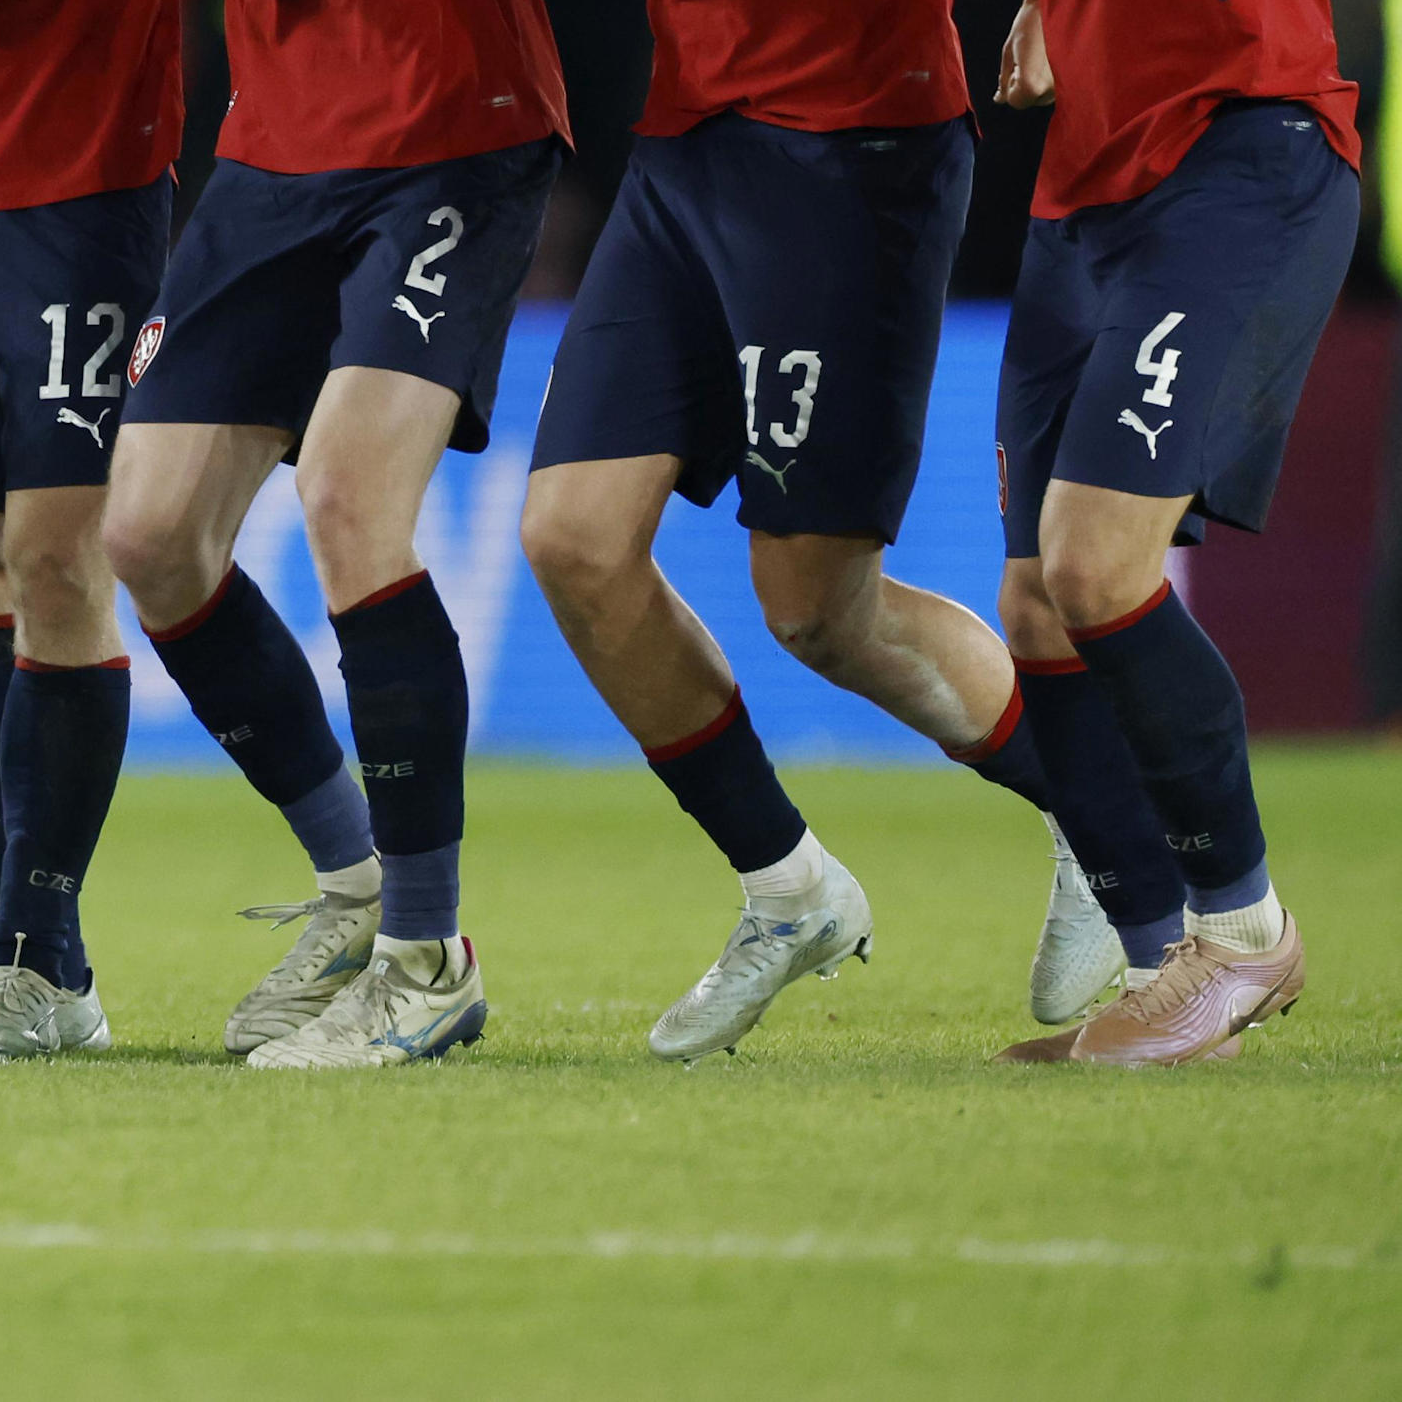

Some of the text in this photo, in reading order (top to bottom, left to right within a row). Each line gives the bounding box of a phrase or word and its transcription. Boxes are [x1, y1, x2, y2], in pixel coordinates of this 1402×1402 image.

[403, 206, 464, 297] 2
[37, 302, 127, 400] 12
[1134, 311, 1186, 409] 4
[737, 345, 823, 449] 13
[360, 760, 414, 779] CZE
[28, 868, 75, 894] CZE
[1084, 871, 1120, 891] ZE
